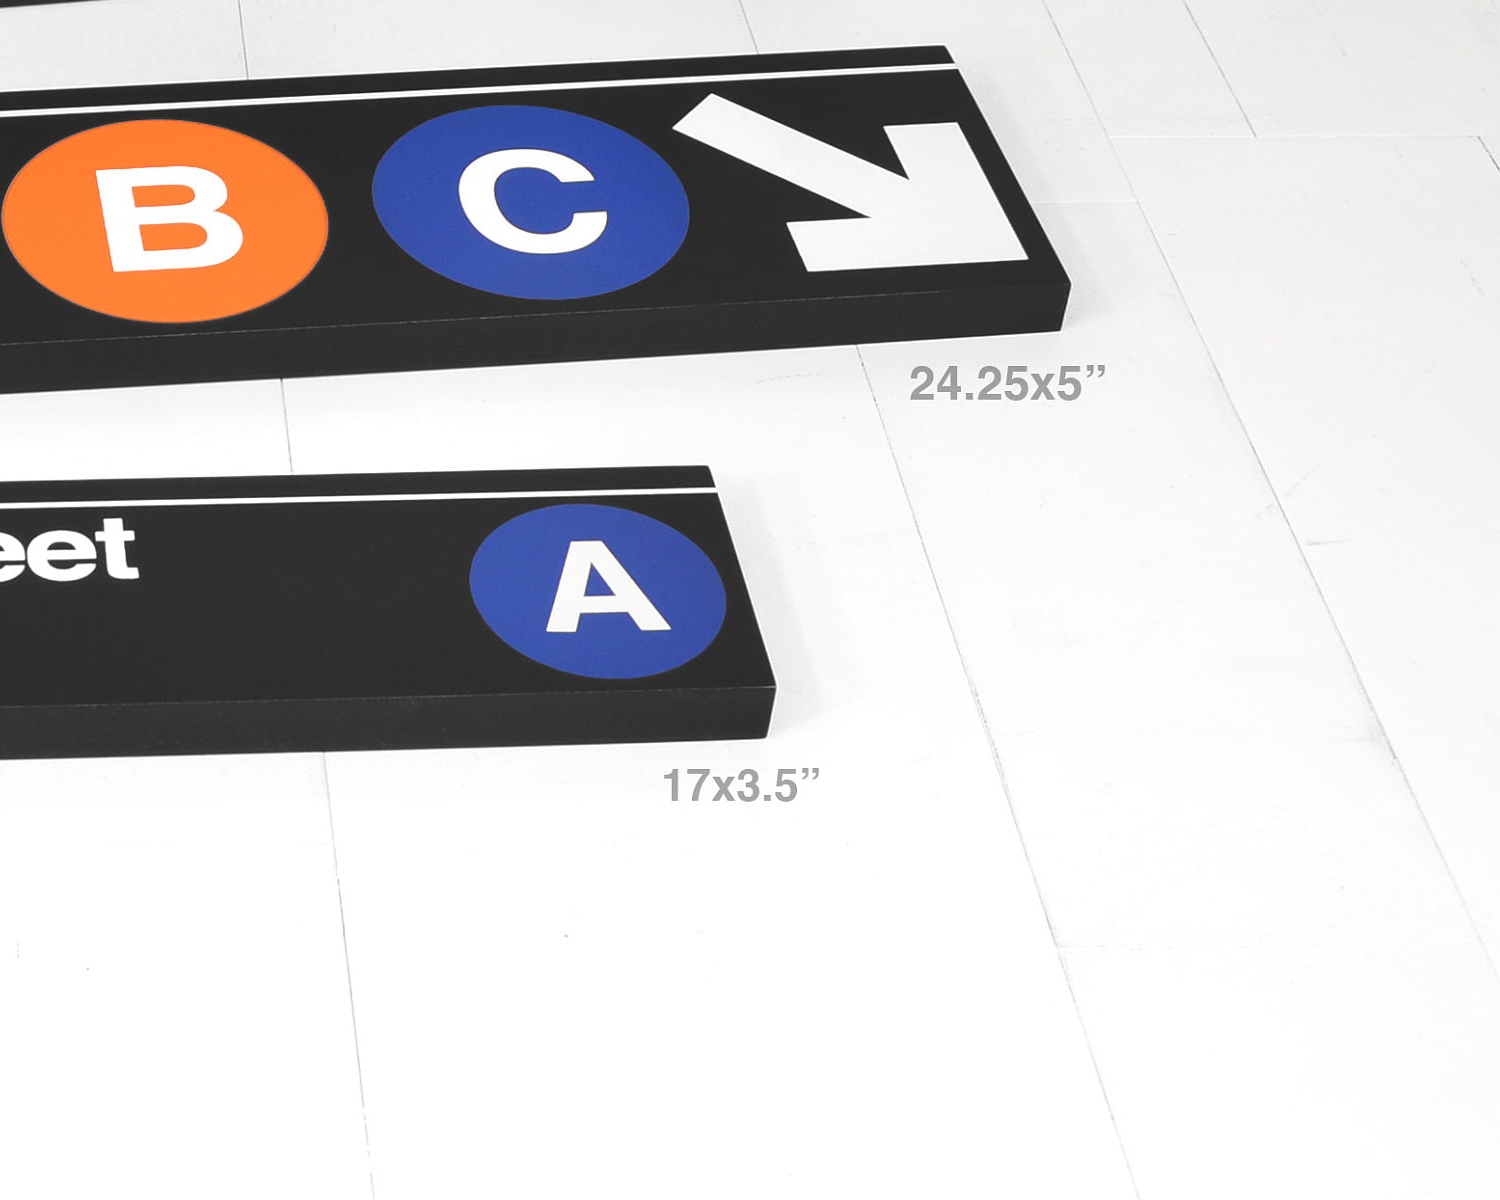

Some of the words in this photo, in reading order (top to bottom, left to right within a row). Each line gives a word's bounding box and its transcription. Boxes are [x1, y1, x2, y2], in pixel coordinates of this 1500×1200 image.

[95, 165, 244, 273] B
[458, 148, 608, 255] C
[546, 539, 672, 633] A
